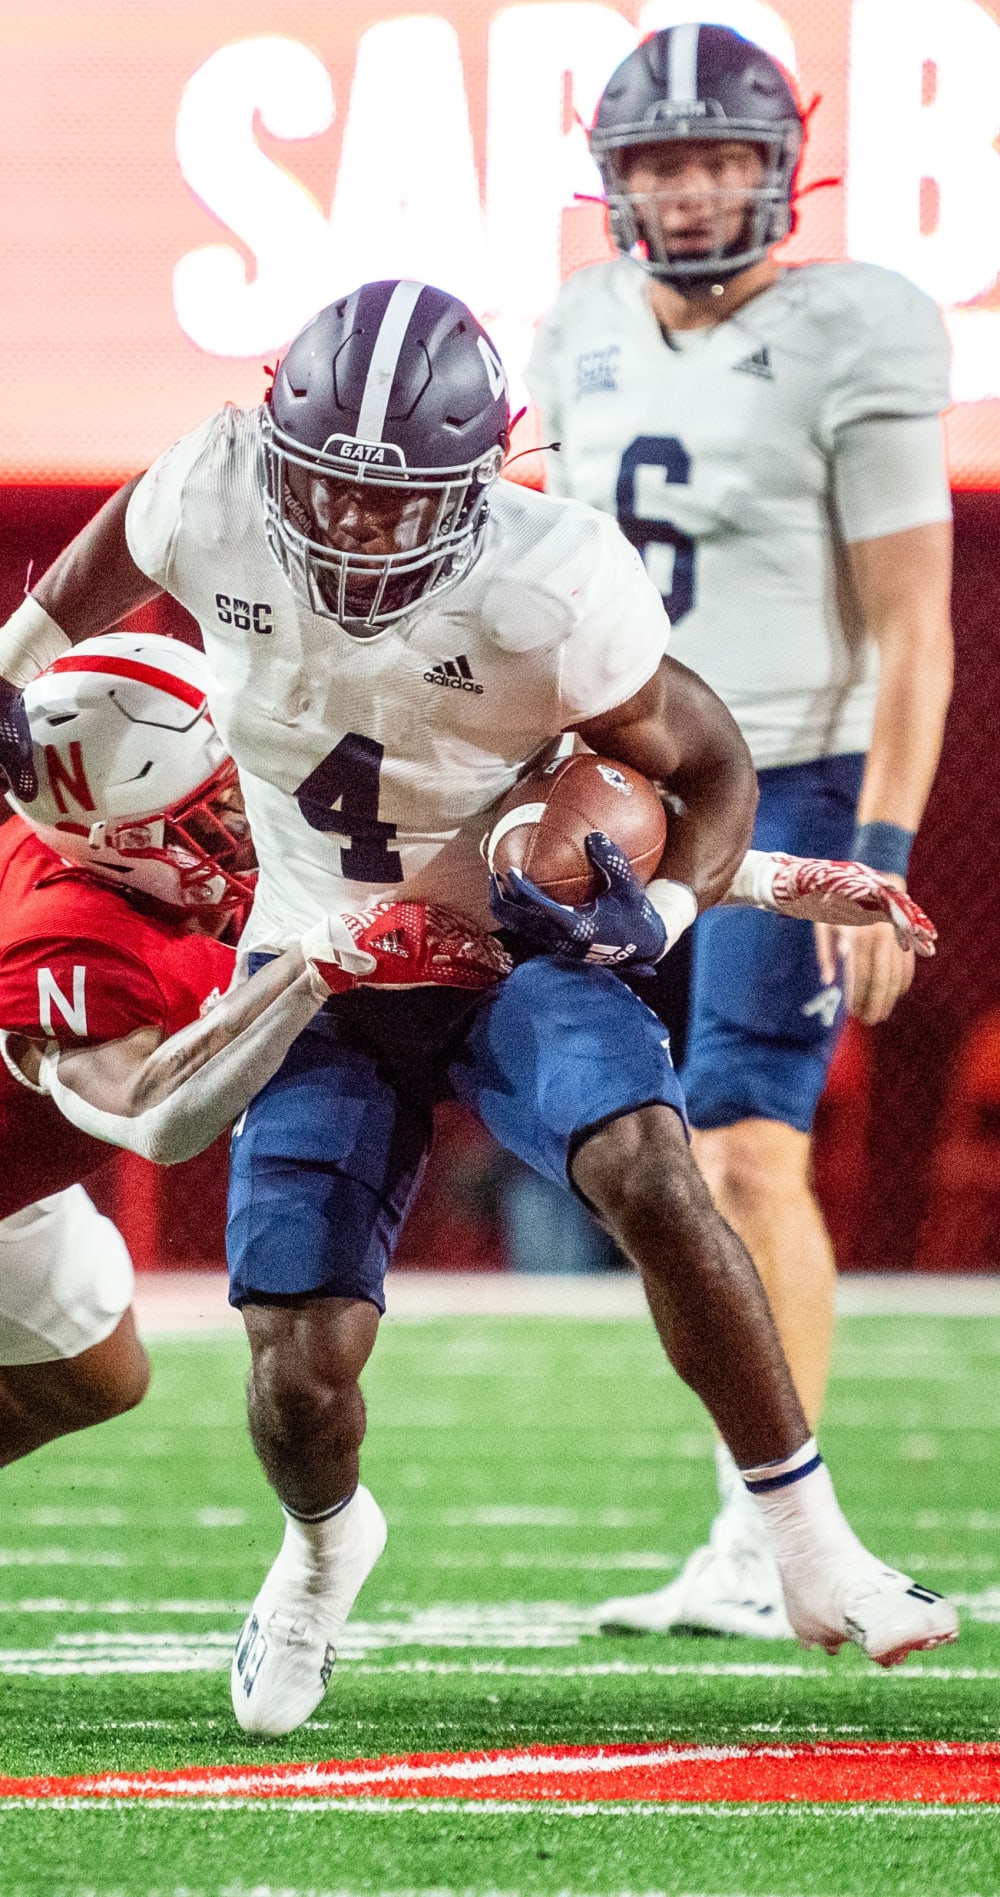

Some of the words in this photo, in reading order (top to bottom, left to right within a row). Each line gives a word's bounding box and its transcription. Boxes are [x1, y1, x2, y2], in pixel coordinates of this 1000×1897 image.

[340, 443, 385, 463] GATA
[617, 436, 695, 626] 6
[216, 593, 273, 635] SBC
[423, 671, 484, 694] adidas
[44, 741, 97, 814] N
[293, 732, 404, 883] 4
[37, 965, 88, 1036] N
